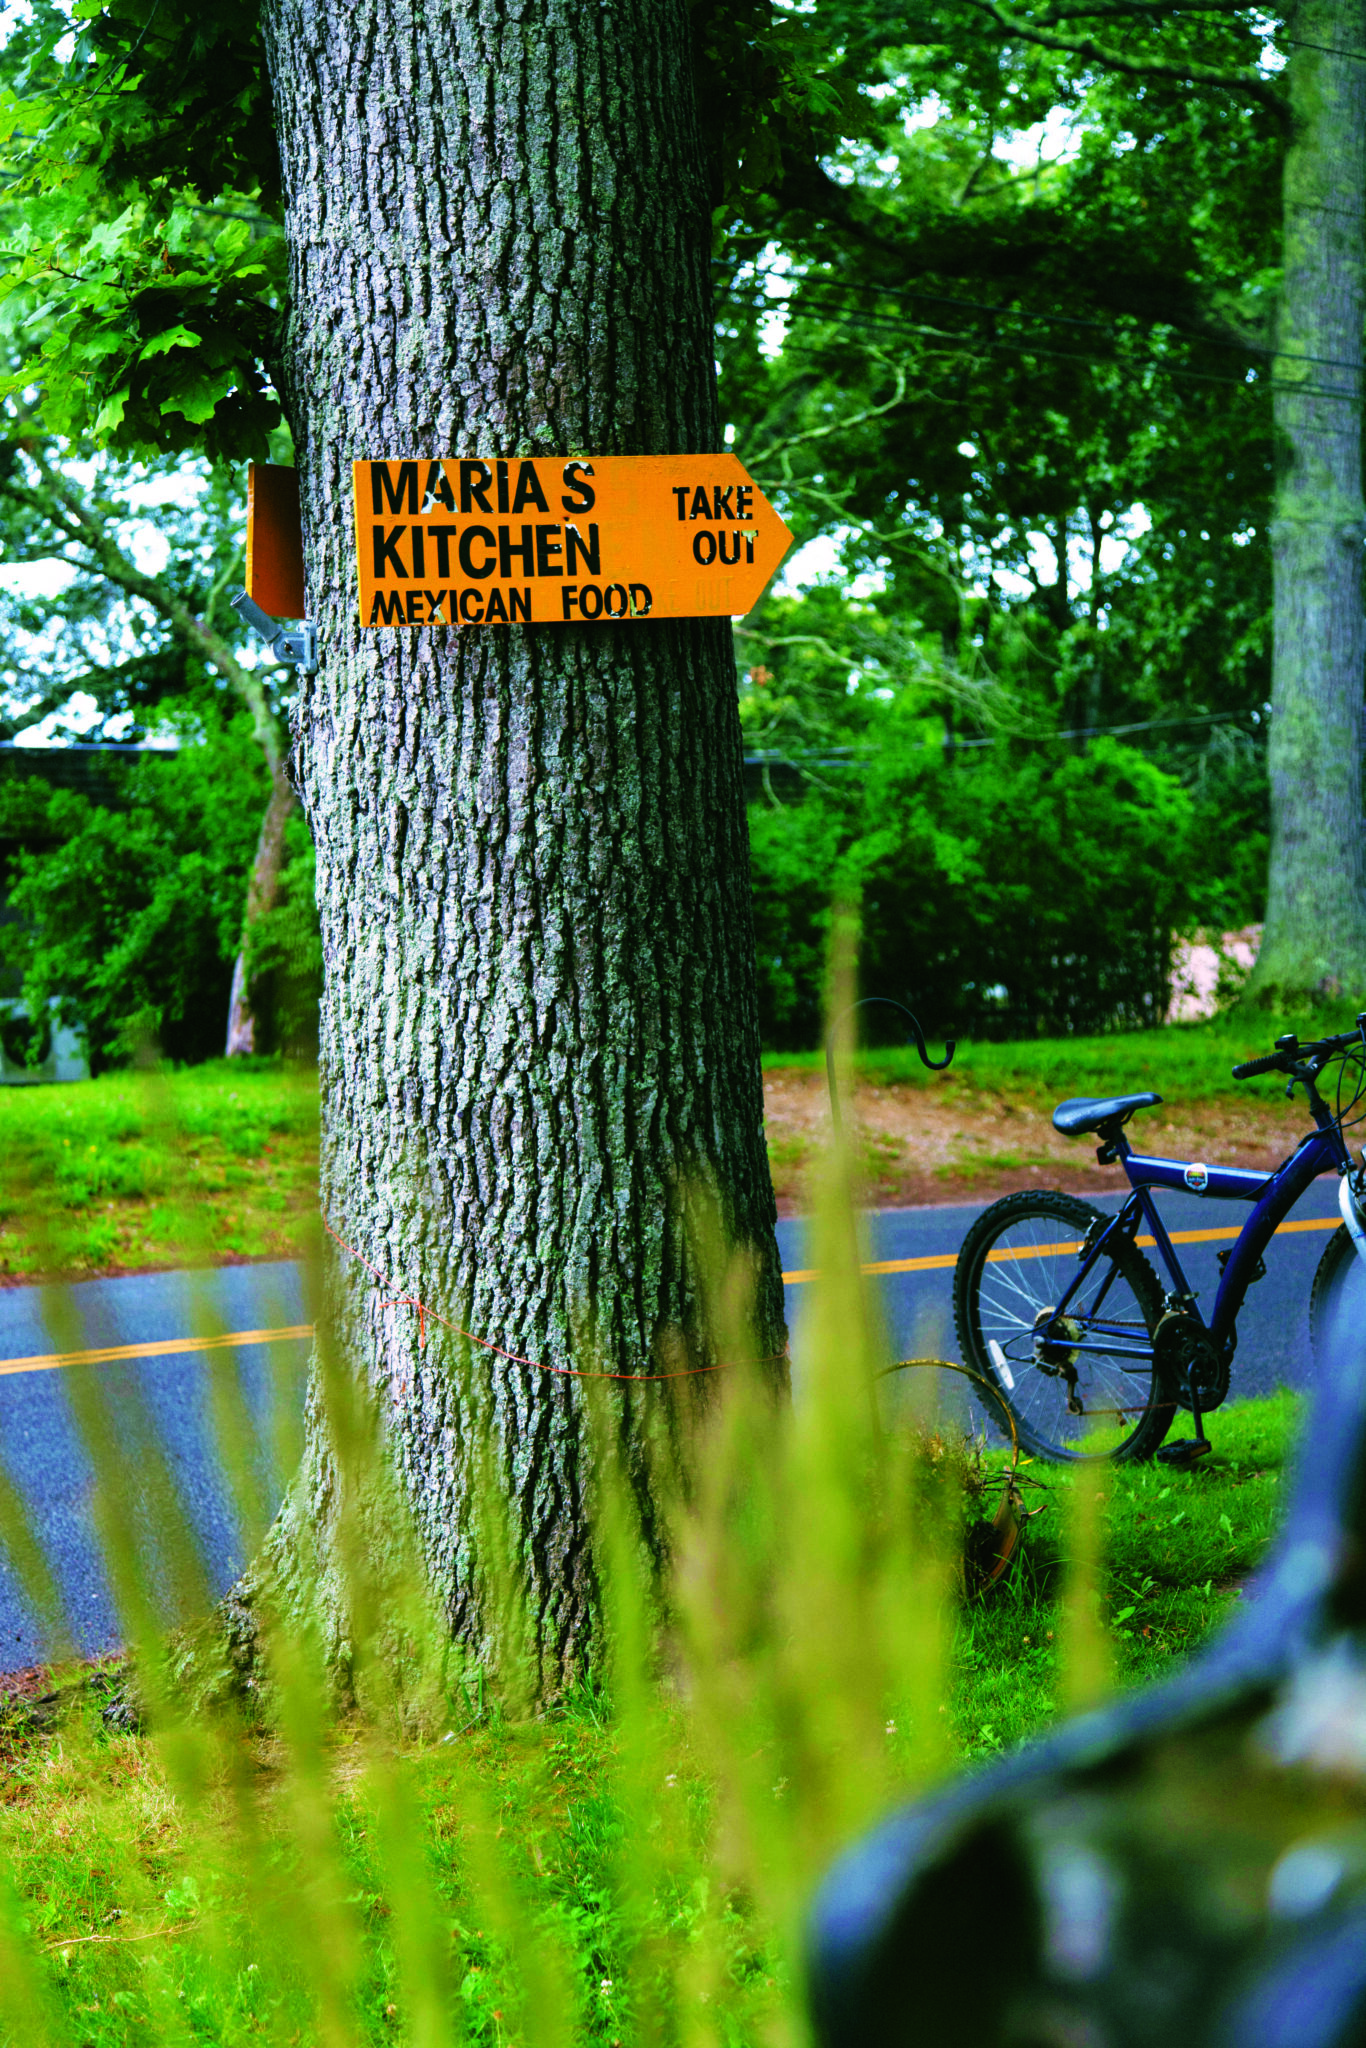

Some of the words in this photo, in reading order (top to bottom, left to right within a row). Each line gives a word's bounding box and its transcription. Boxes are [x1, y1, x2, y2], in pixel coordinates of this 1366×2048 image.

[672, 485, 753, 521] TAKE
[372, 522, 601, 580] KITCHEN
[692, 529, 759, 566] OUT
[369, 587, 532, 625] MEXICAN
[561, 583, 653, 620] FOOD
